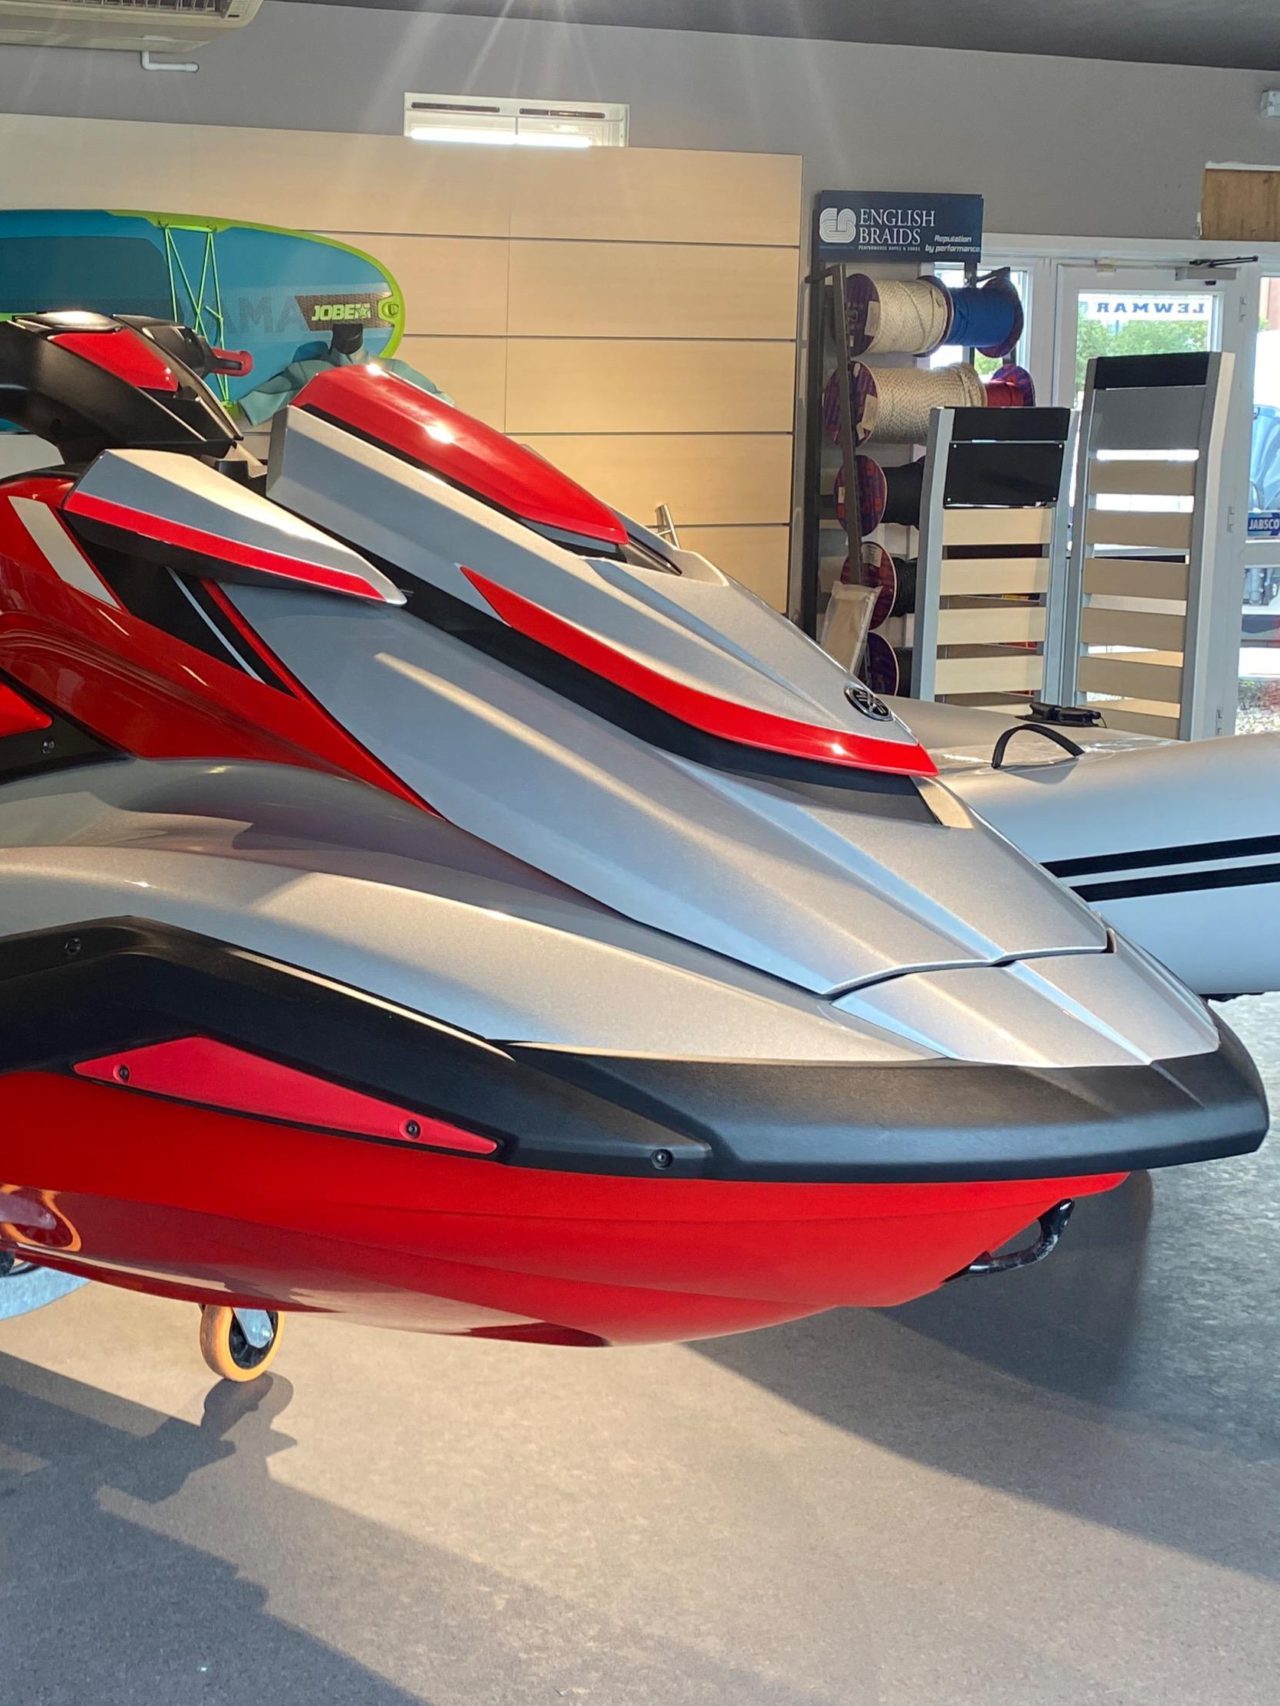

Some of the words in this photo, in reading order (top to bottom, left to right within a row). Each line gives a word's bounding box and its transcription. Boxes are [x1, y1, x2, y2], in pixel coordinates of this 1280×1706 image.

[860, 208, 935, 227] ENGLISH
[859, 227, 921, 245] BRAIDS
[934, 234, 972, 243] Reputation
[925, 244, 934, 253] by
[935, 245, 980, 253] performance
[311, 304, 355, 321] JOBE
[1249, 518, 1280, 530] JABSCO
